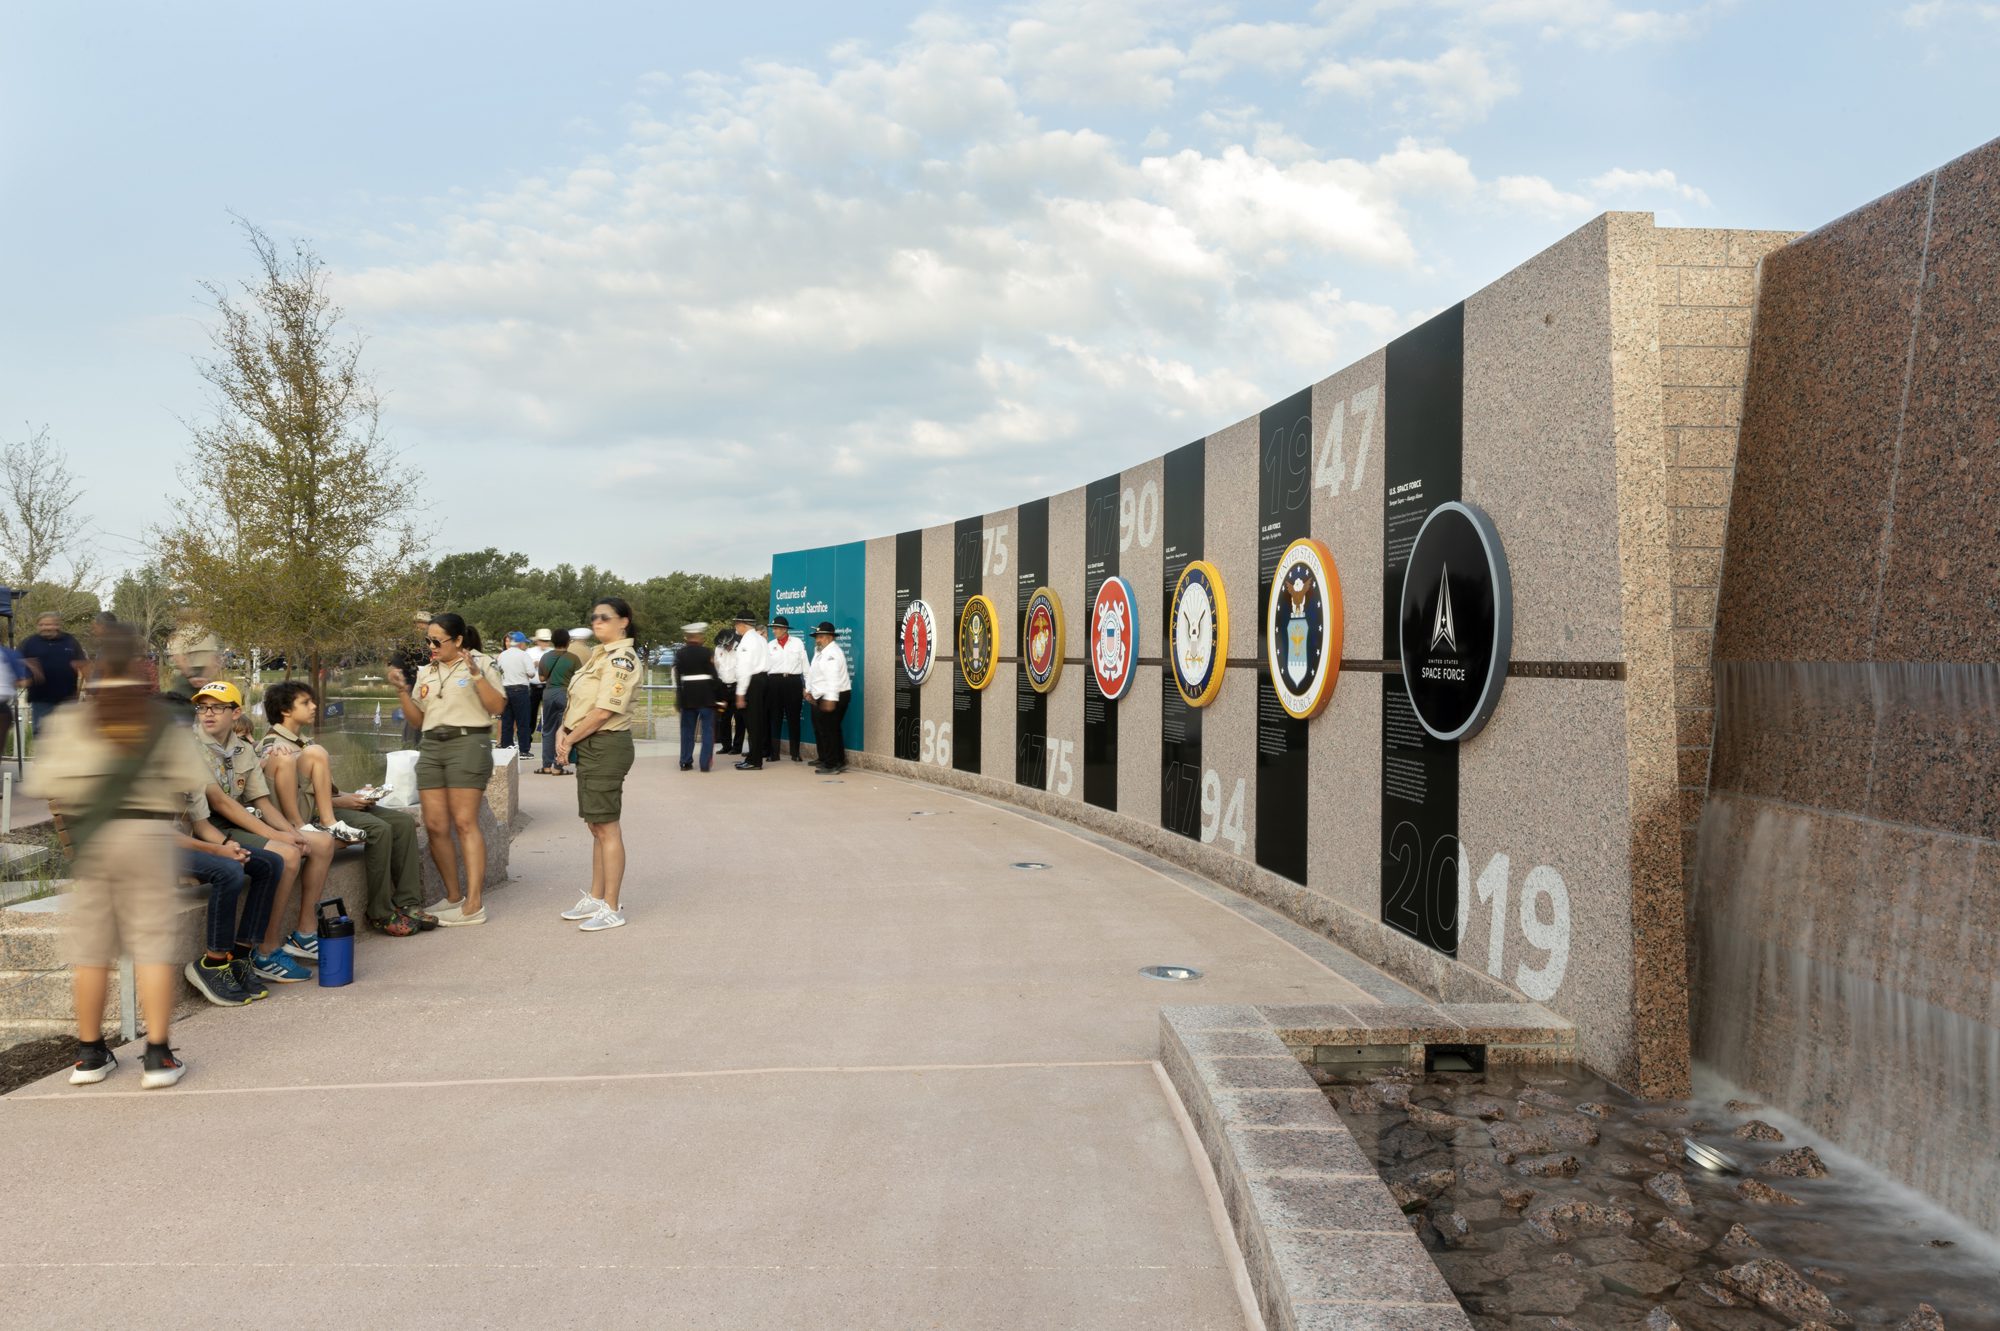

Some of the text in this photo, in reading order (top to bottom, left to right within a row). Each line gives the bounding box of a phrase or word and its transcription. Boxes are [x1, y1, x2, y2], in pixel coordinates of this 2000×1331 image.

[1265, 383, 1380, 515] 1947
[1397, 483, 1409, 493] SPACE
[1088, 480, 1159, 558] 1790
[957, 525, 1009, 580] 1775
[1278, 550, 1300, 580] UNITED
[1300, 550, 1322, 574] STATES
[775, 586, 807, 600] Centuries of
[775, 600, 829, 615] Service and Sacrifice
[1172, 576, 1190, 646] UNITED
[1200, 577, 1218, 647] STATES
[900, 601, 920, 640] NATIONAL
[920, 605, 932, 641] GUARD
[1184, 682, 1204, 698] NAVY
[1421, 667, 1465, 681] SPACE FORCE
[1281, 690, 1313, 708] AIR FORCE
[896, 716, 951, 767] 1636
[1018, 732, 1074, 797] 1775
[1165, 760, 1247, 856] 1794
[1384, 821, 1571, 1001] 2019
